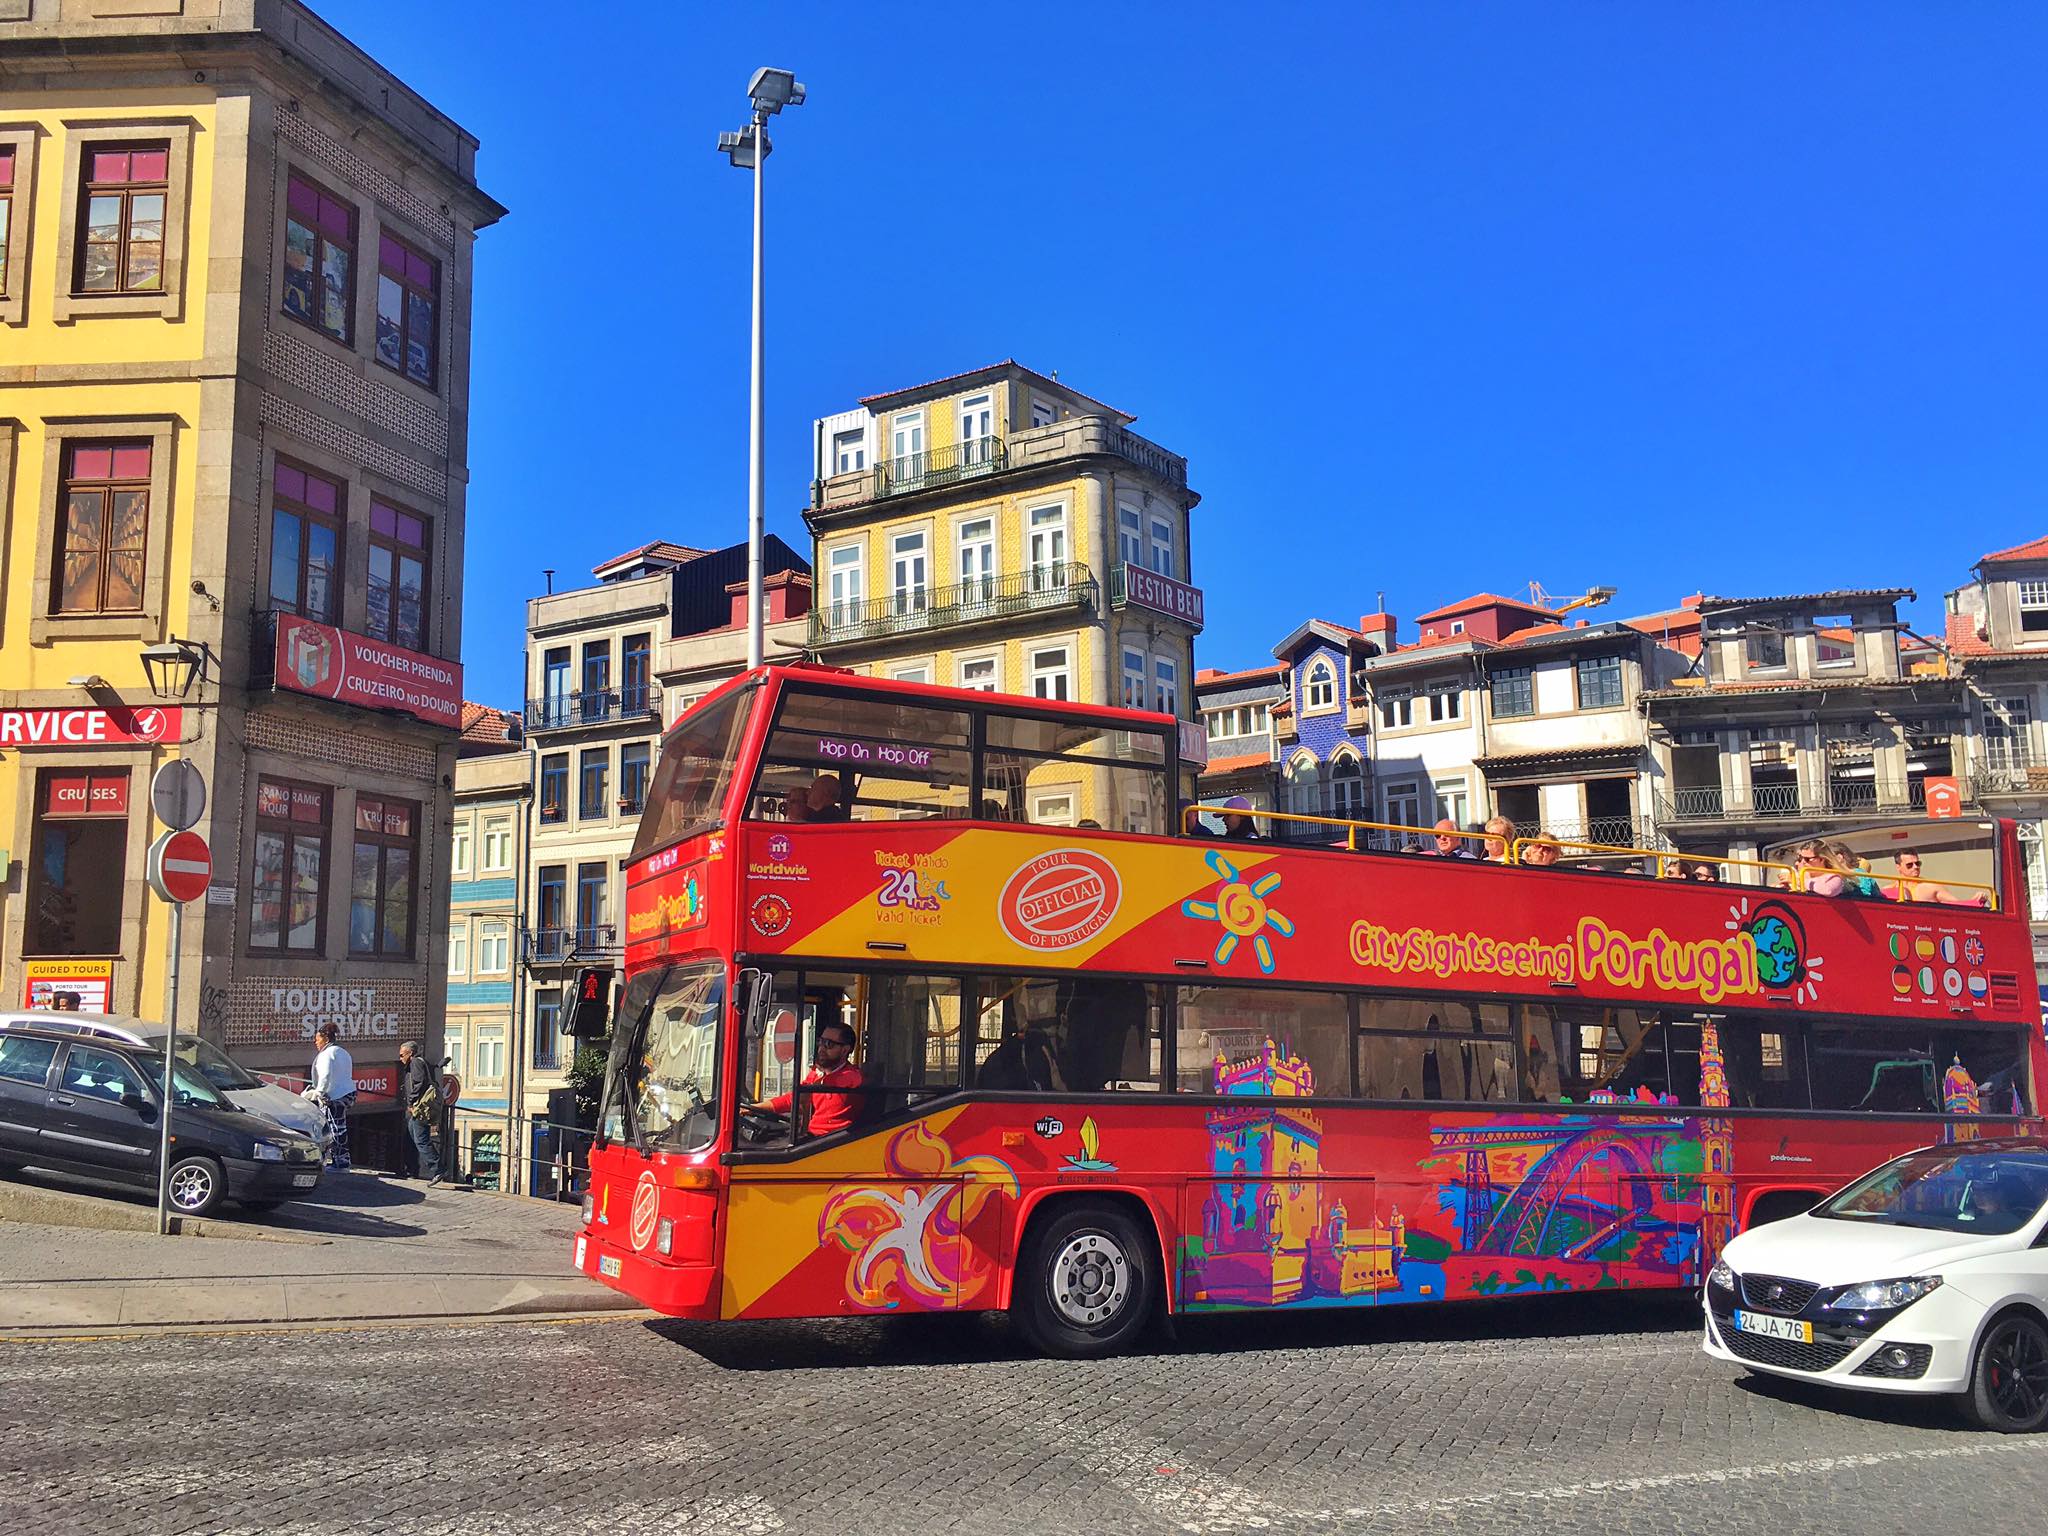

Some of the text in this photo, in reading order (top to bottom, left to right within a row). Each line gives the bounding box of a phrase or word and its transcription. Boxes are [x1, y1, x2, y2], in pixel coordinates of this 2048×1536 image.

[1127, 569, 1201, 620] VESTIR BEM
[354, 645, 453, 686] VOUCHER PRENDA
[347, 676, 457, 716] CRUZEIRO NO DOURO
[1, 711, 106, 741] RVICE
[819, 740, 930, 765] Hop On Hop Off
[262, 802, 289, 815] TOUR
[263, 786, 321, 807] PANORAMIC
[749, 863, 808, 874] Worldwide
[874, 850, 910, 868] Ticket
[1028, 853, 1070, 875] TOUR
[1021, 879, 1101, 919] OFFICIAL
[876, 909, 942, 925] Valid Ticket
[1030, 910, 1110, 946] OF PORTUGAL
[32, 965, 106, 974] GUIDED TOURS
[1350, 916, 1759, 1004] CitySightseeing Portugal
[271, 989, 377, 1013] TOURIST
[353, 1077, 387, 1092] TOURS
